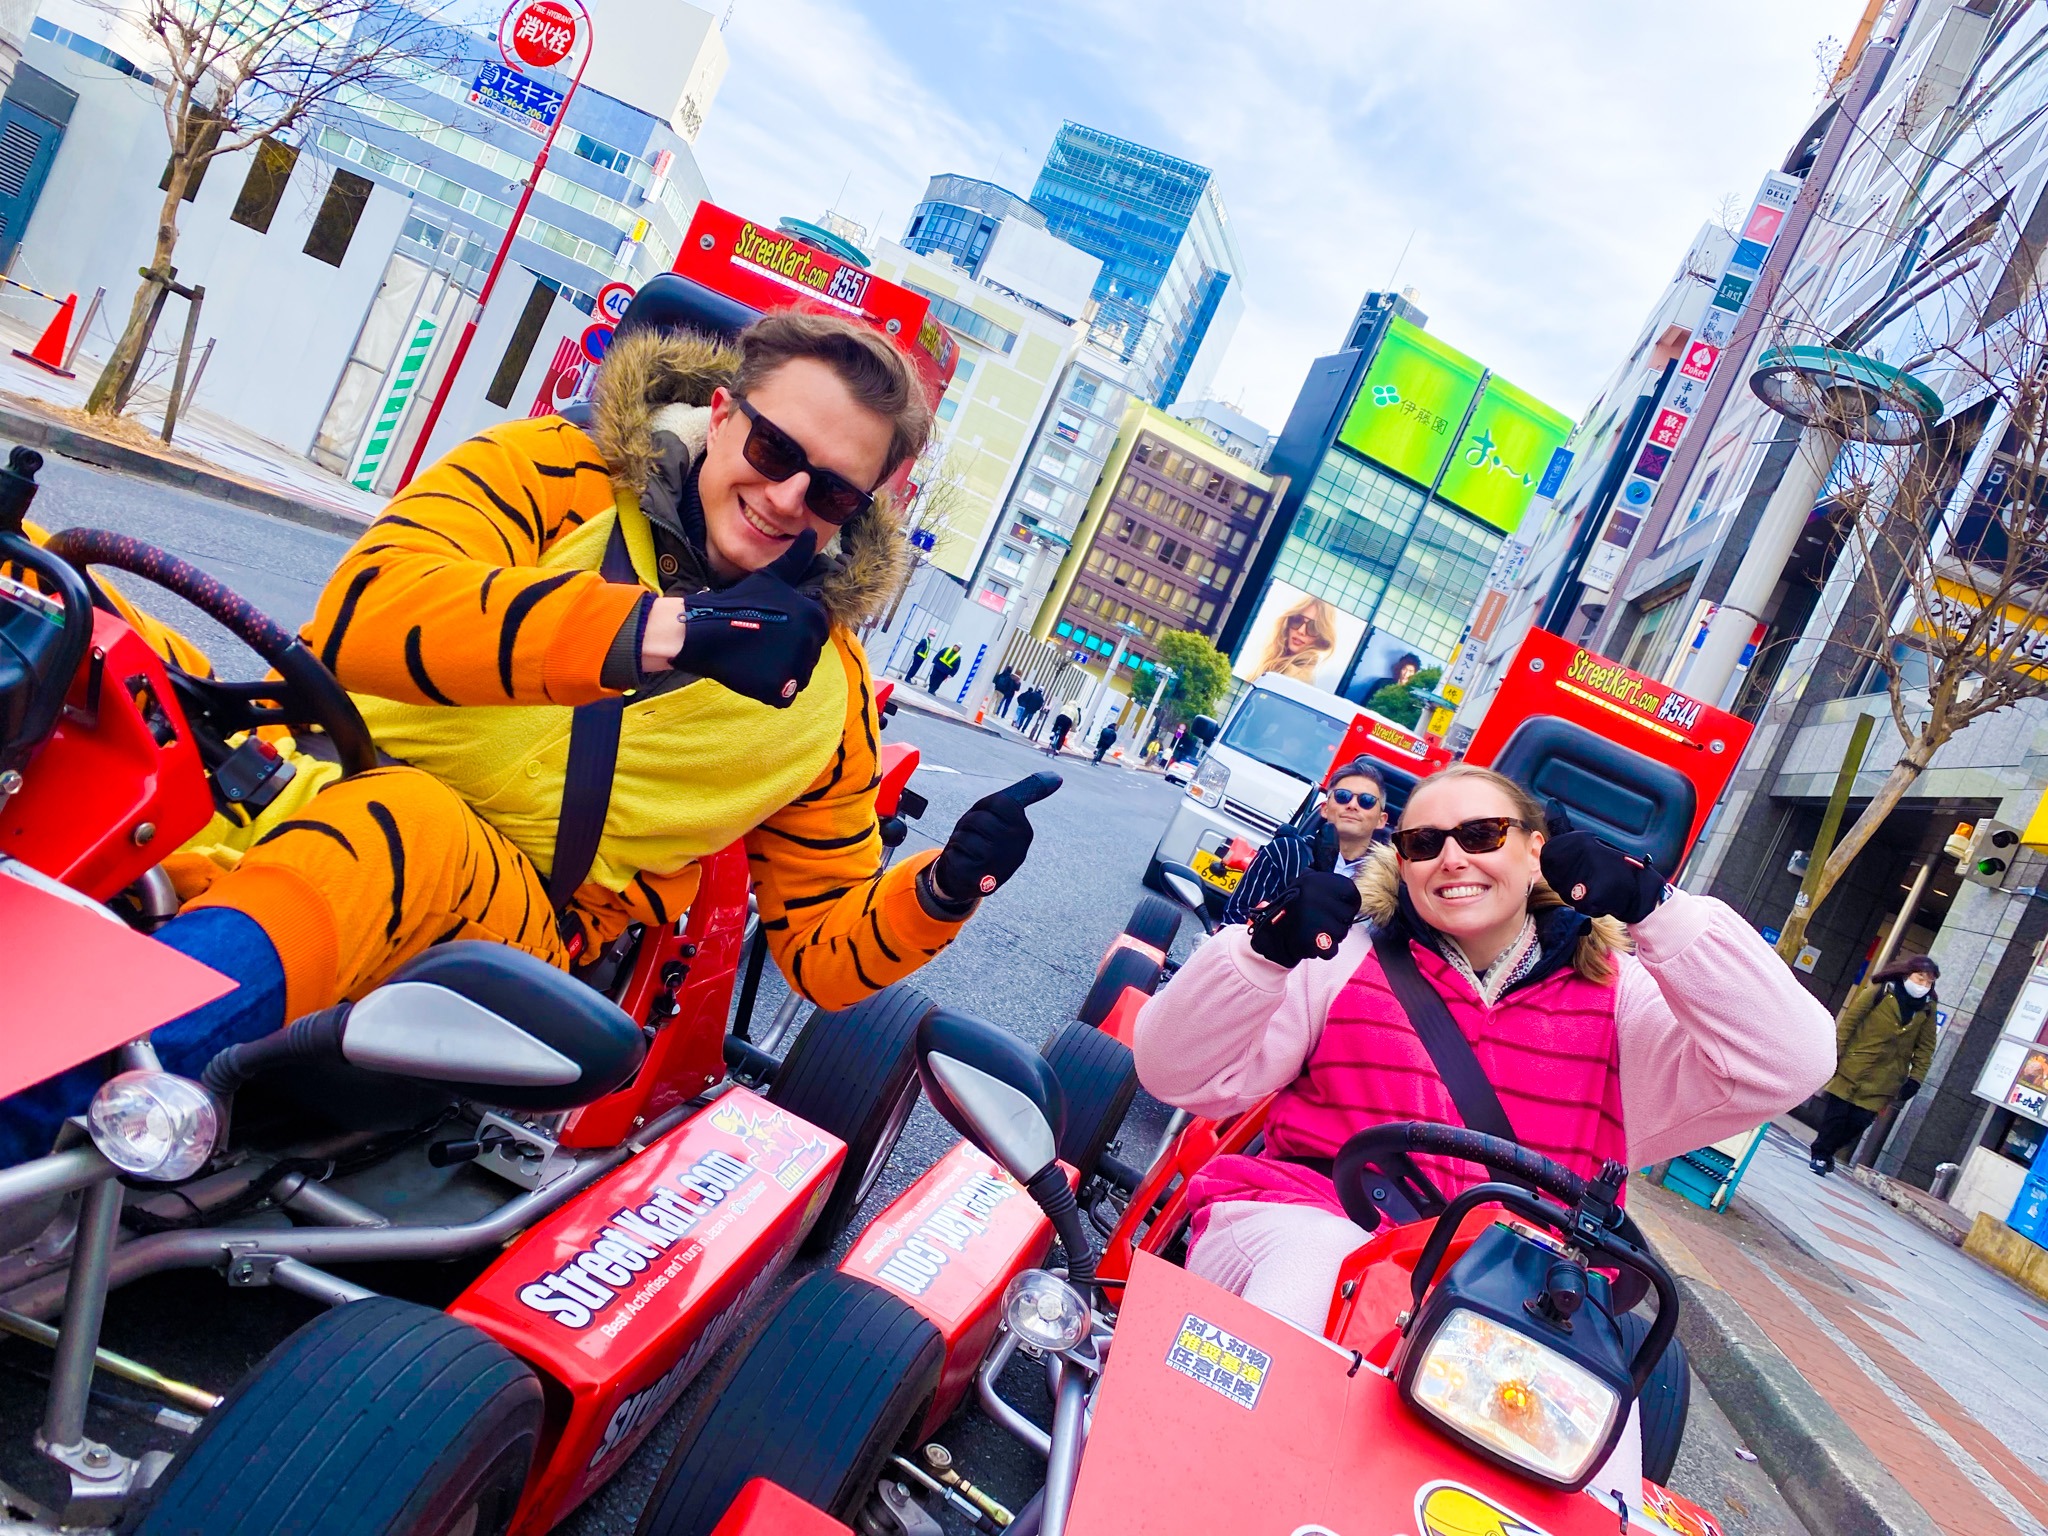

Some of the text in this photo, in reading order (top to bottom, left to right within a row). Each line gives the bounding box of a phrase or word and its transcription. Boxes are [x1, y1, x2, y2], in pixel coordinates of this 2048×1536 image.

[516, 12, 571, 55] 消火栓
[532, 3, 573, 25] FIRE HYDRANT
[485, 87, 547, 122] 03-3464-2061
[1764, 196, 1787, 207] TOWER
[1766, 188, 1790, 201] DELI
[734, 222, 872, 307] StreetKart.com #551
[1682, 363, 1708, 379] Poker
[1400, 398, 1448, 436] 伊藤園
[1567, 649, 1702, 730] StreetKart.com #544
[600, 1311, 632, 1340] Best
[629, 1274, 668, 1319] Activities
[663, 1260, 684, 1284] and
[676, 1240, 704, 1273] Tours
[704, 1218, 729, 1242] Japan
[722, 1212, 737, 1227] by
[1185, 1317, 1268, 1370] 対人対物
[1172, 1346, 1256, 1401] 任意保険
